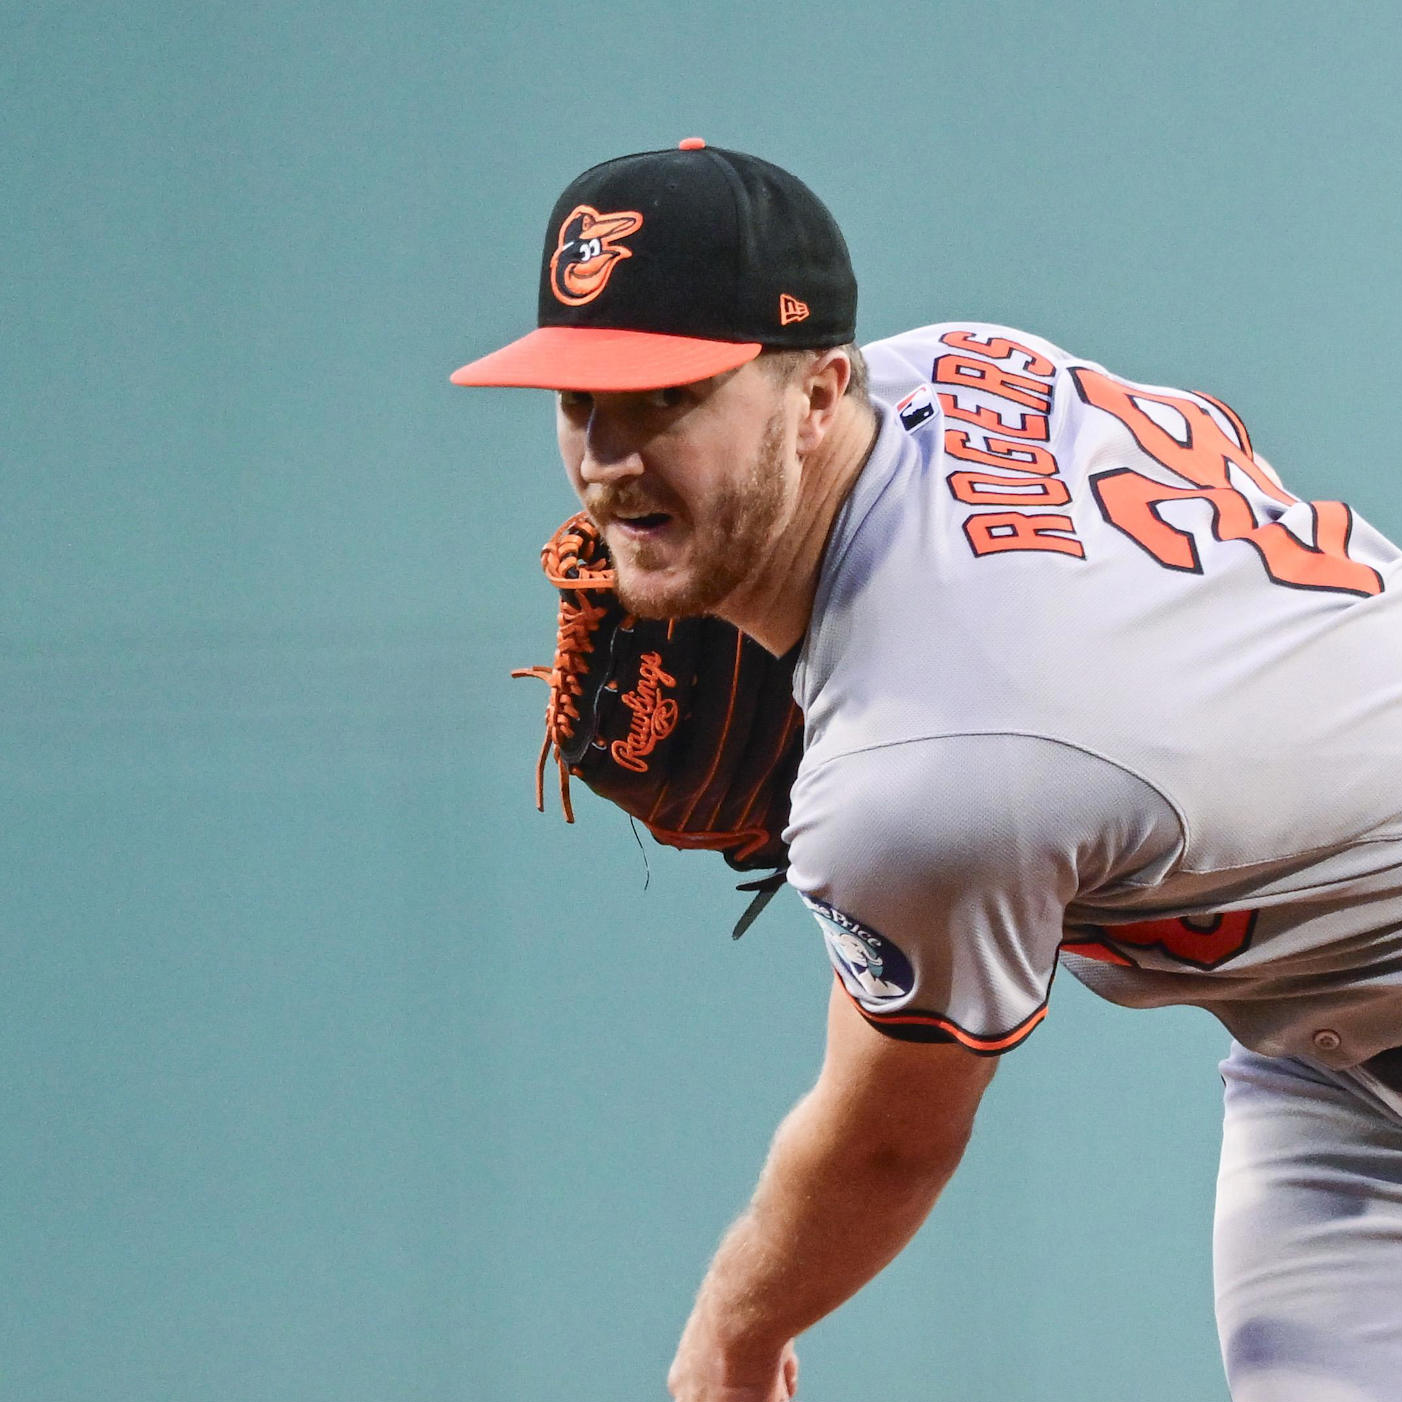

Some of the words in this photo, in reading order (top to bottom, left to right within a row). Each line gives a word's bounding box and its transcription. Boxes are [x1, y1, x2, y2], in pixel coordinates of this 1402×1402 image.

[931, 330, 1087, 560] ROGERS
[1067, 365, 1386, 599] 28
[611, 651, 677, 773] Rawlings
